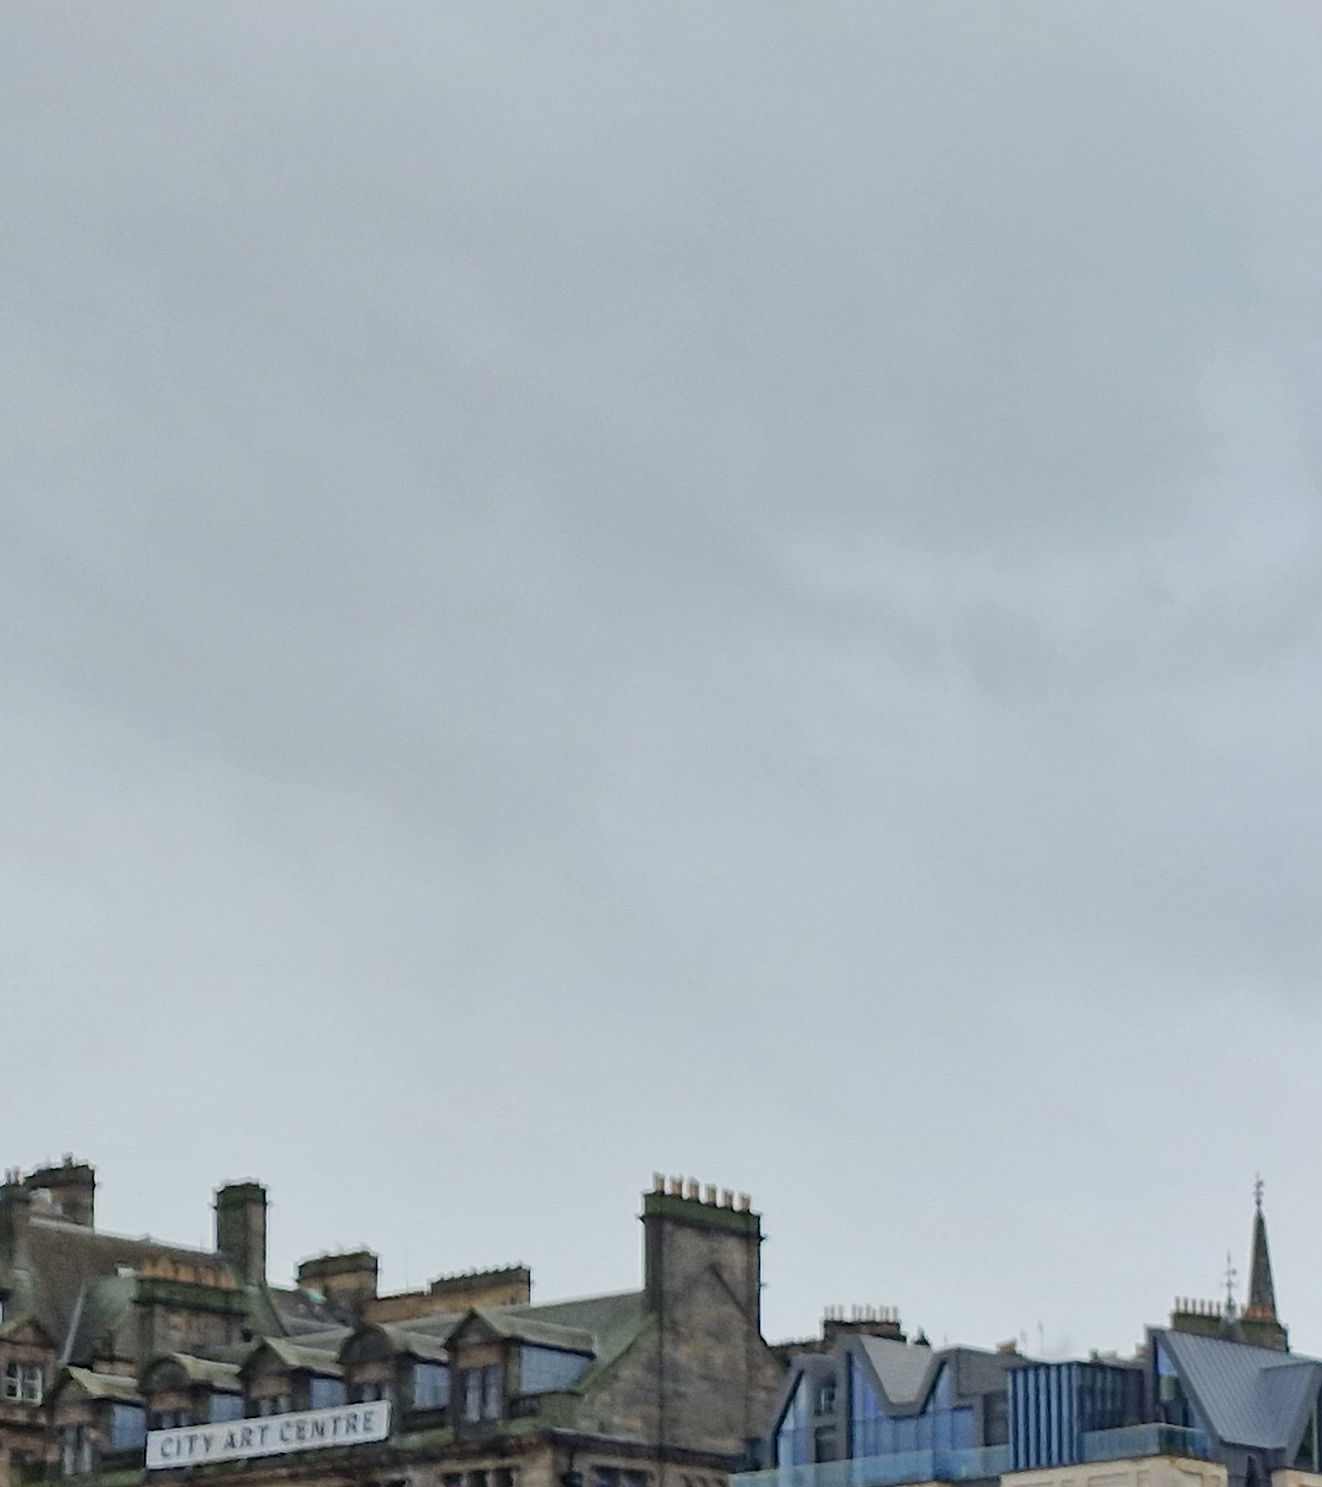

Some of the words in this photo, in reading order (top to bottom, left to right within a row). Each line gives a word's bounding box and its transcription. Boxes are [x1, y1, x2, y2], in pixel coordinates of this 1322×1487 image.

[160, 1432, 213, 1458] CITY
[224, 1424, 269, 1450] ART
[279, 1410, 376, 1442] CENTRE
